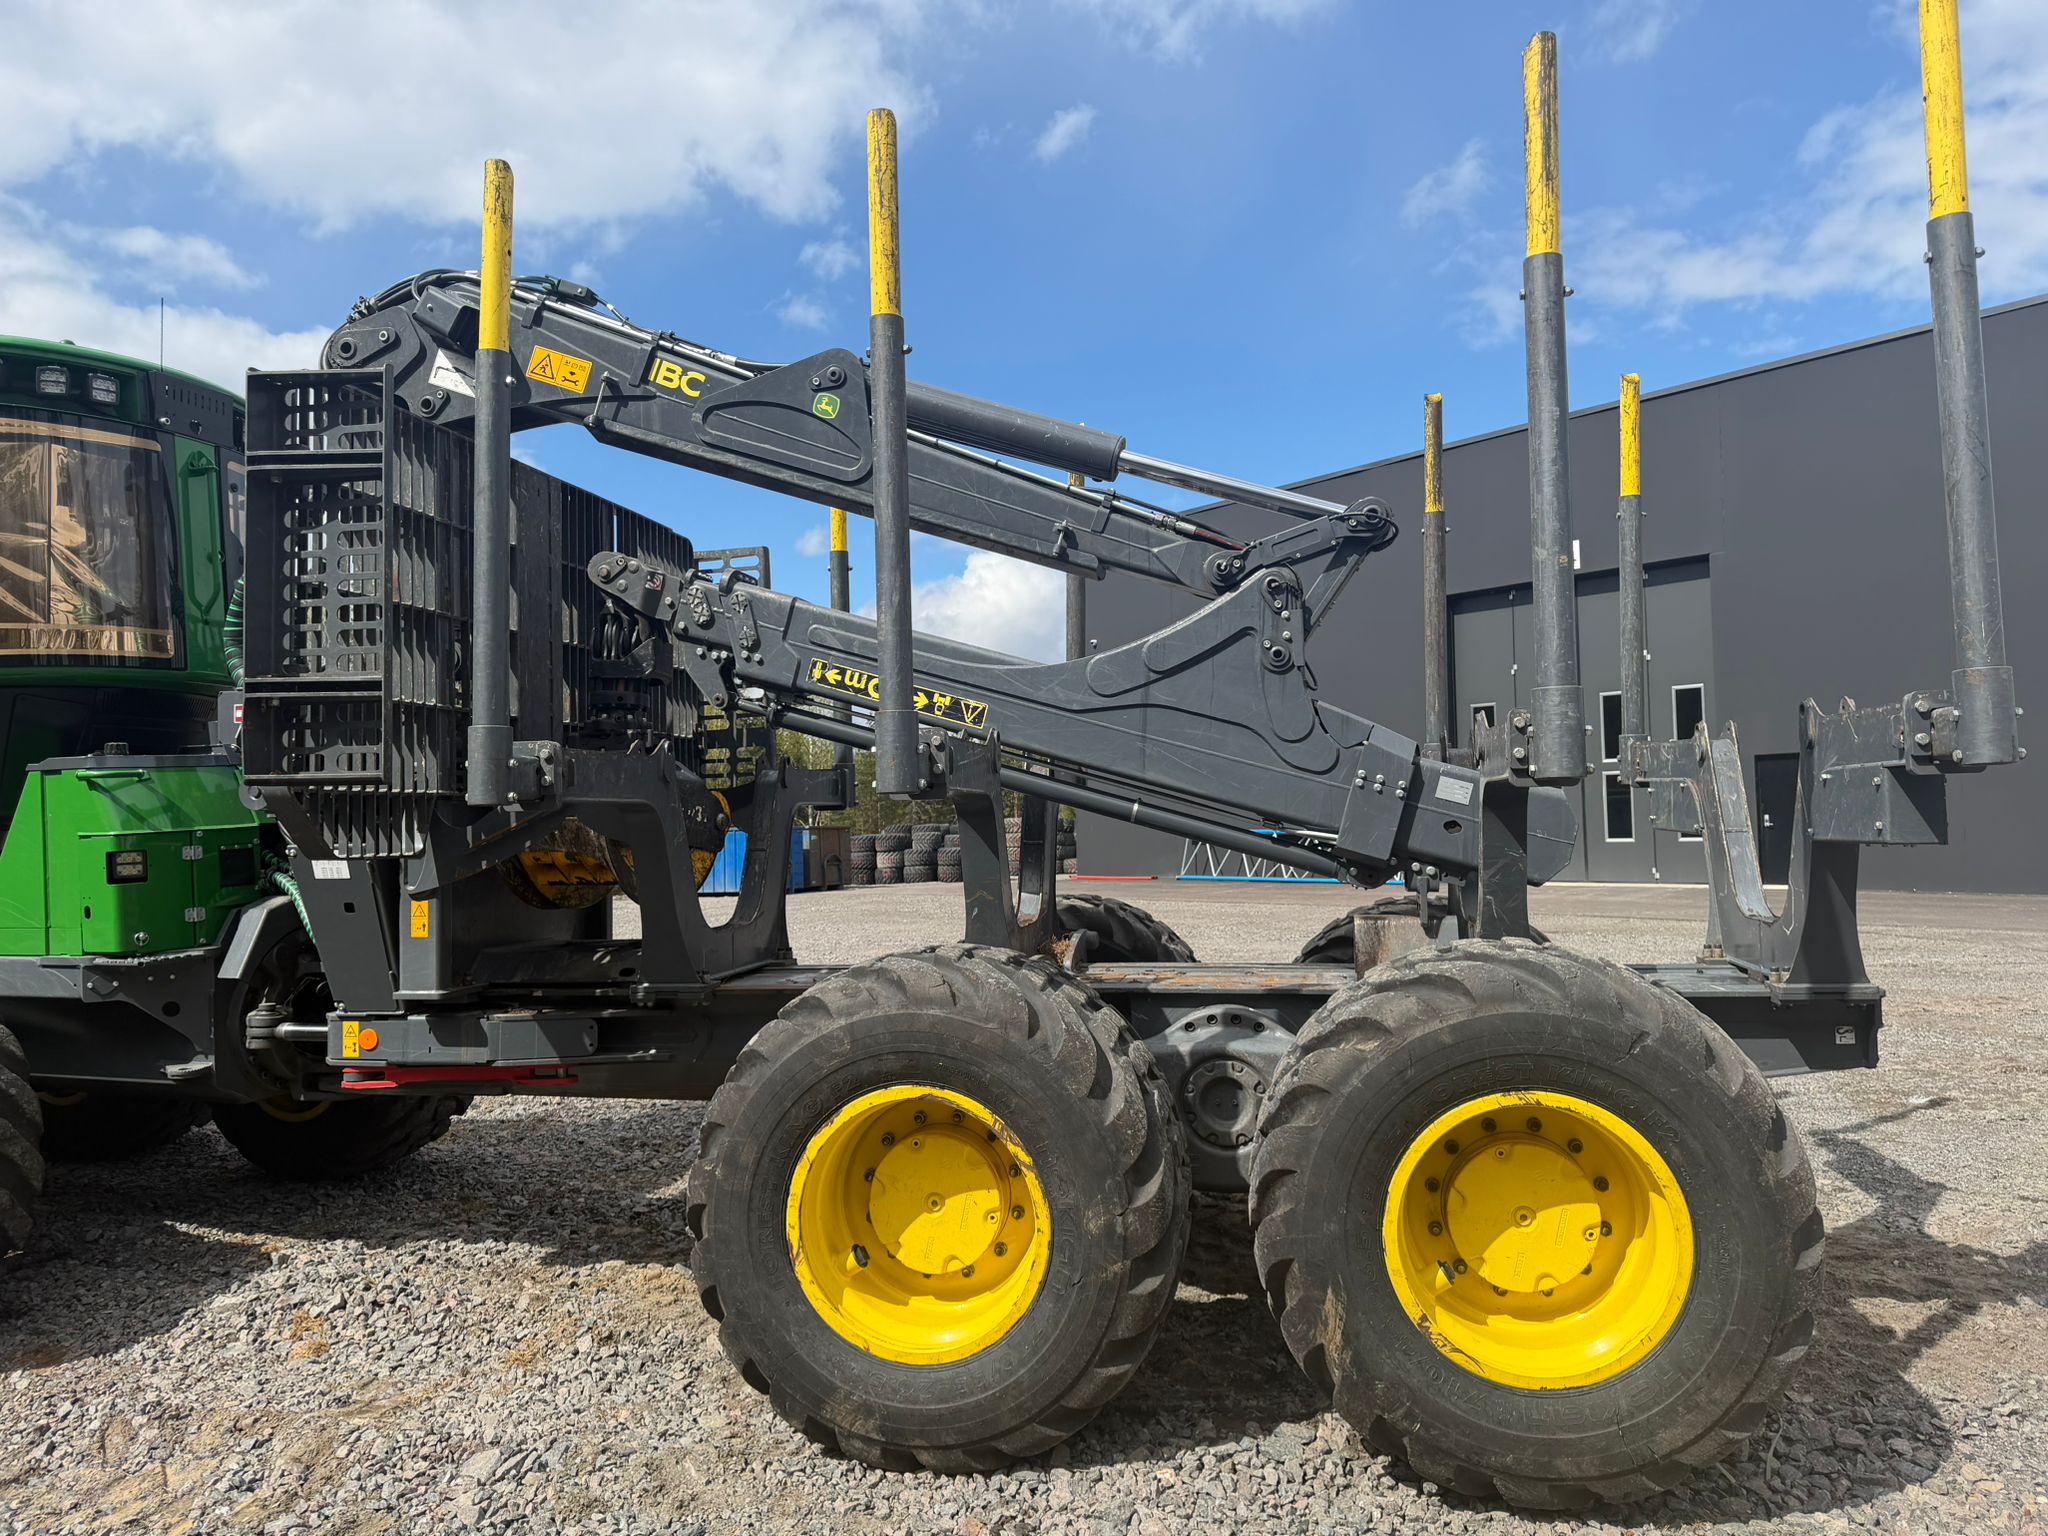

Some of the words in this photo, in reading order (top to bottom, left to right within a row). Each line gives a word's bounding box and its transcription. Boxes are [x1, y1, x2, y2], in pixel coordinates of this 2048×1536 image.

[648, 358, 706, 398] IBC
[1415, 1062, 1535, 1108] FOREST
[1547, 1063, 1641, 1110] KING
[1642, 1108, 1682, 1145] F2
